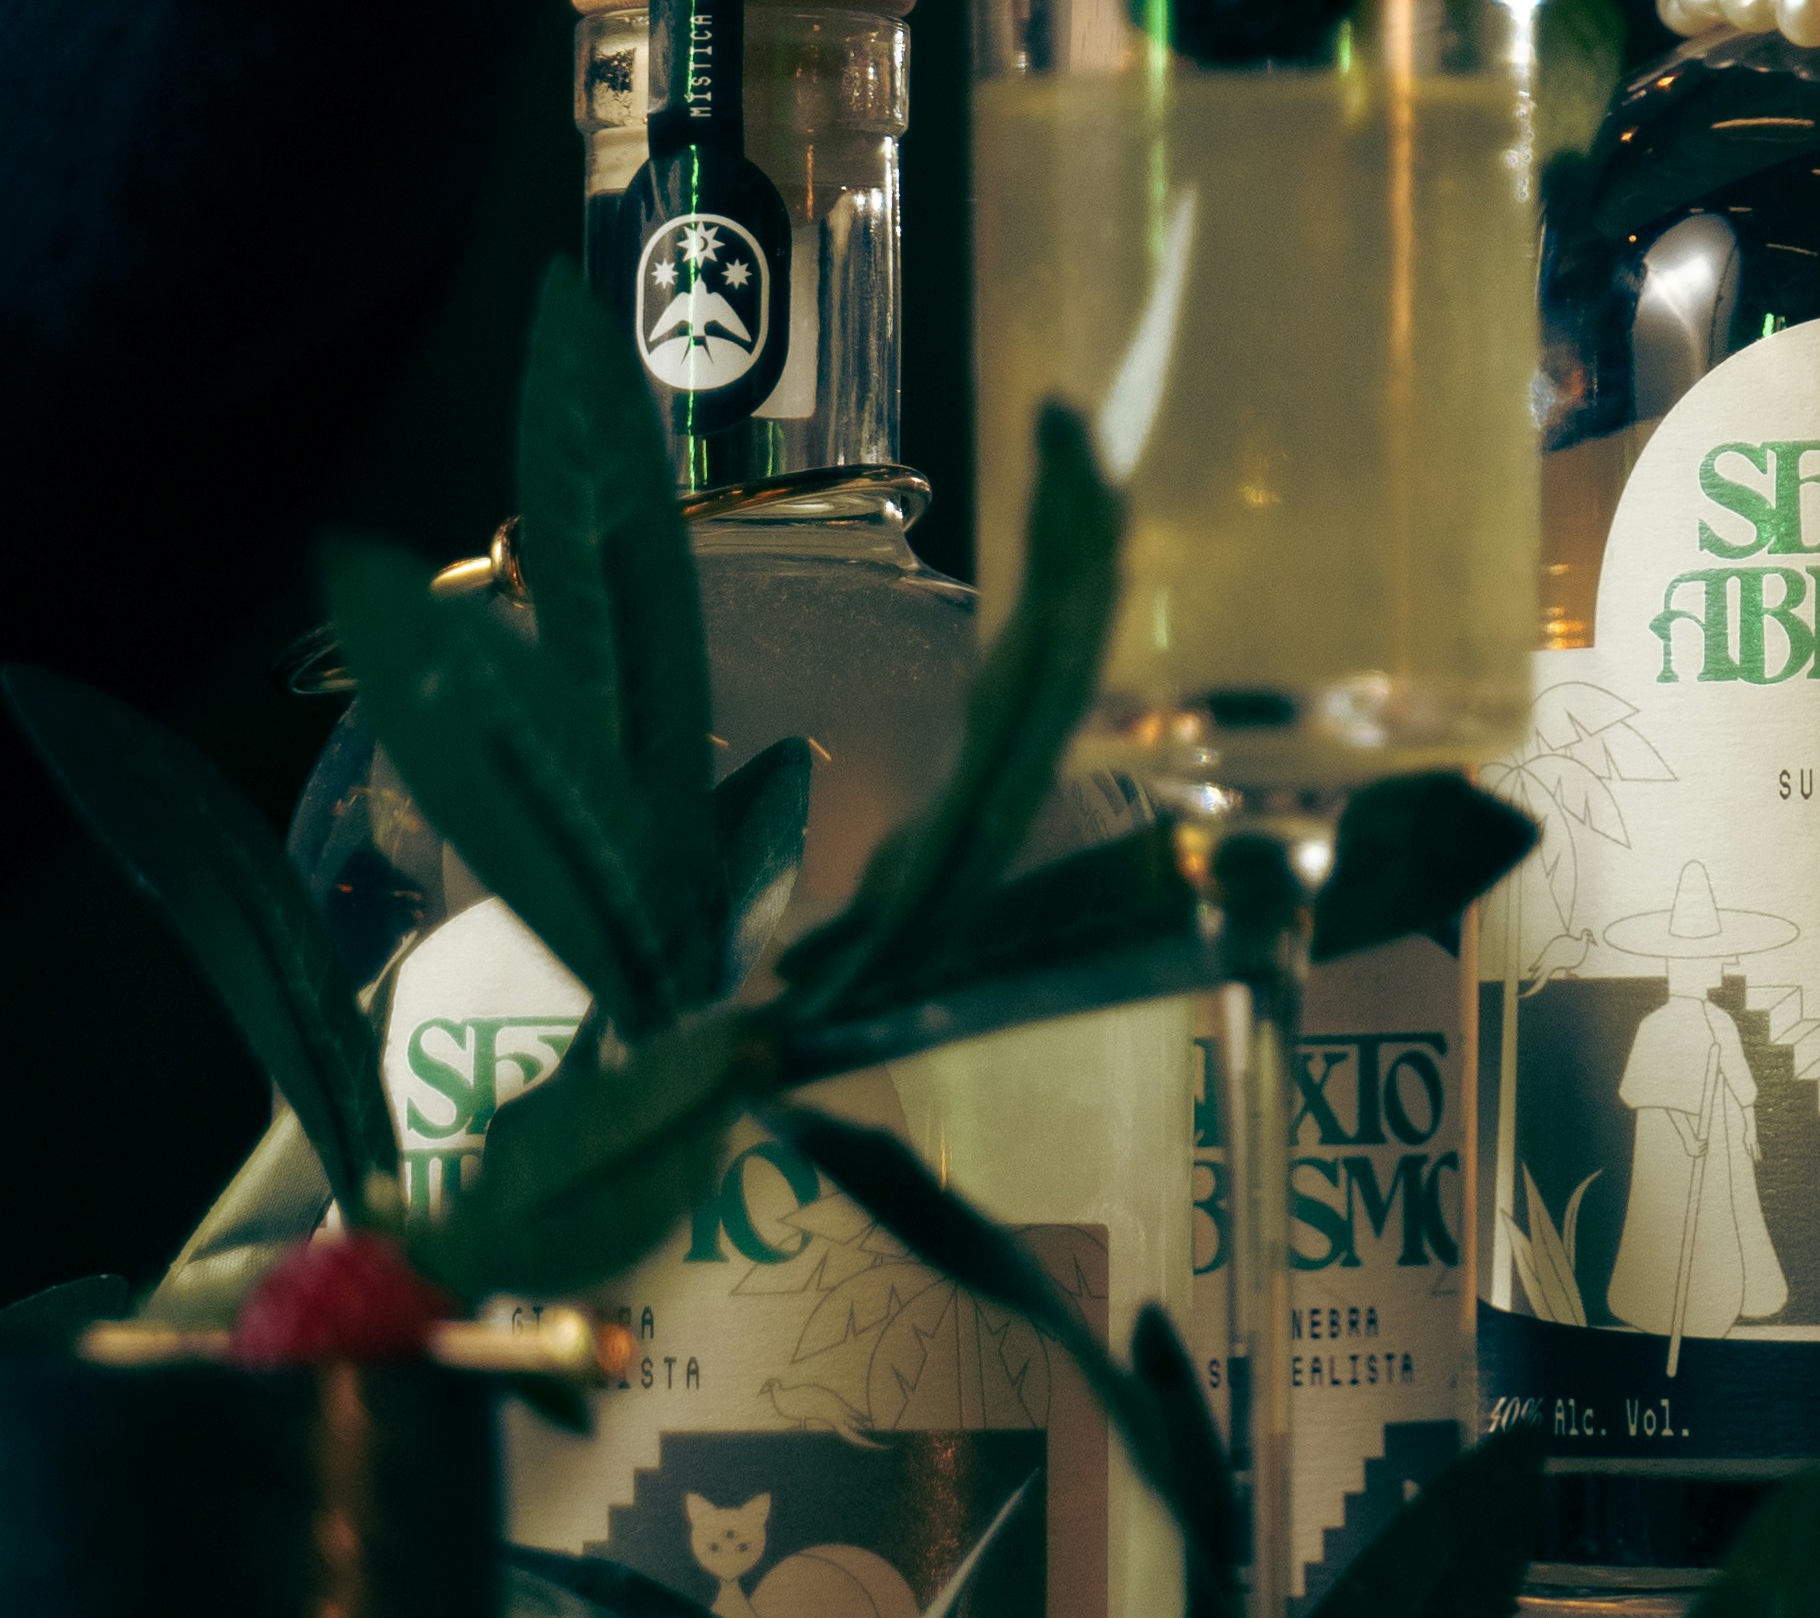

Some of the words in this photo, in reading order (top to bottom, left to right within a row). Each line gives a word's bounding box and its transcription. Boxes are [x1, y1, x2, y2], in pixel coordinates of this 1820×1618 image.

[1194, 1032, 1447, 1146] XTO
[1291, 1305, 1380, 1340] NEBRA
[1208, 1351, 1414, 1390] SEALISTA
[1554, 1397, 1607, 1437] Alc.
[1625, 1398, 1691, 1438] Vol.
